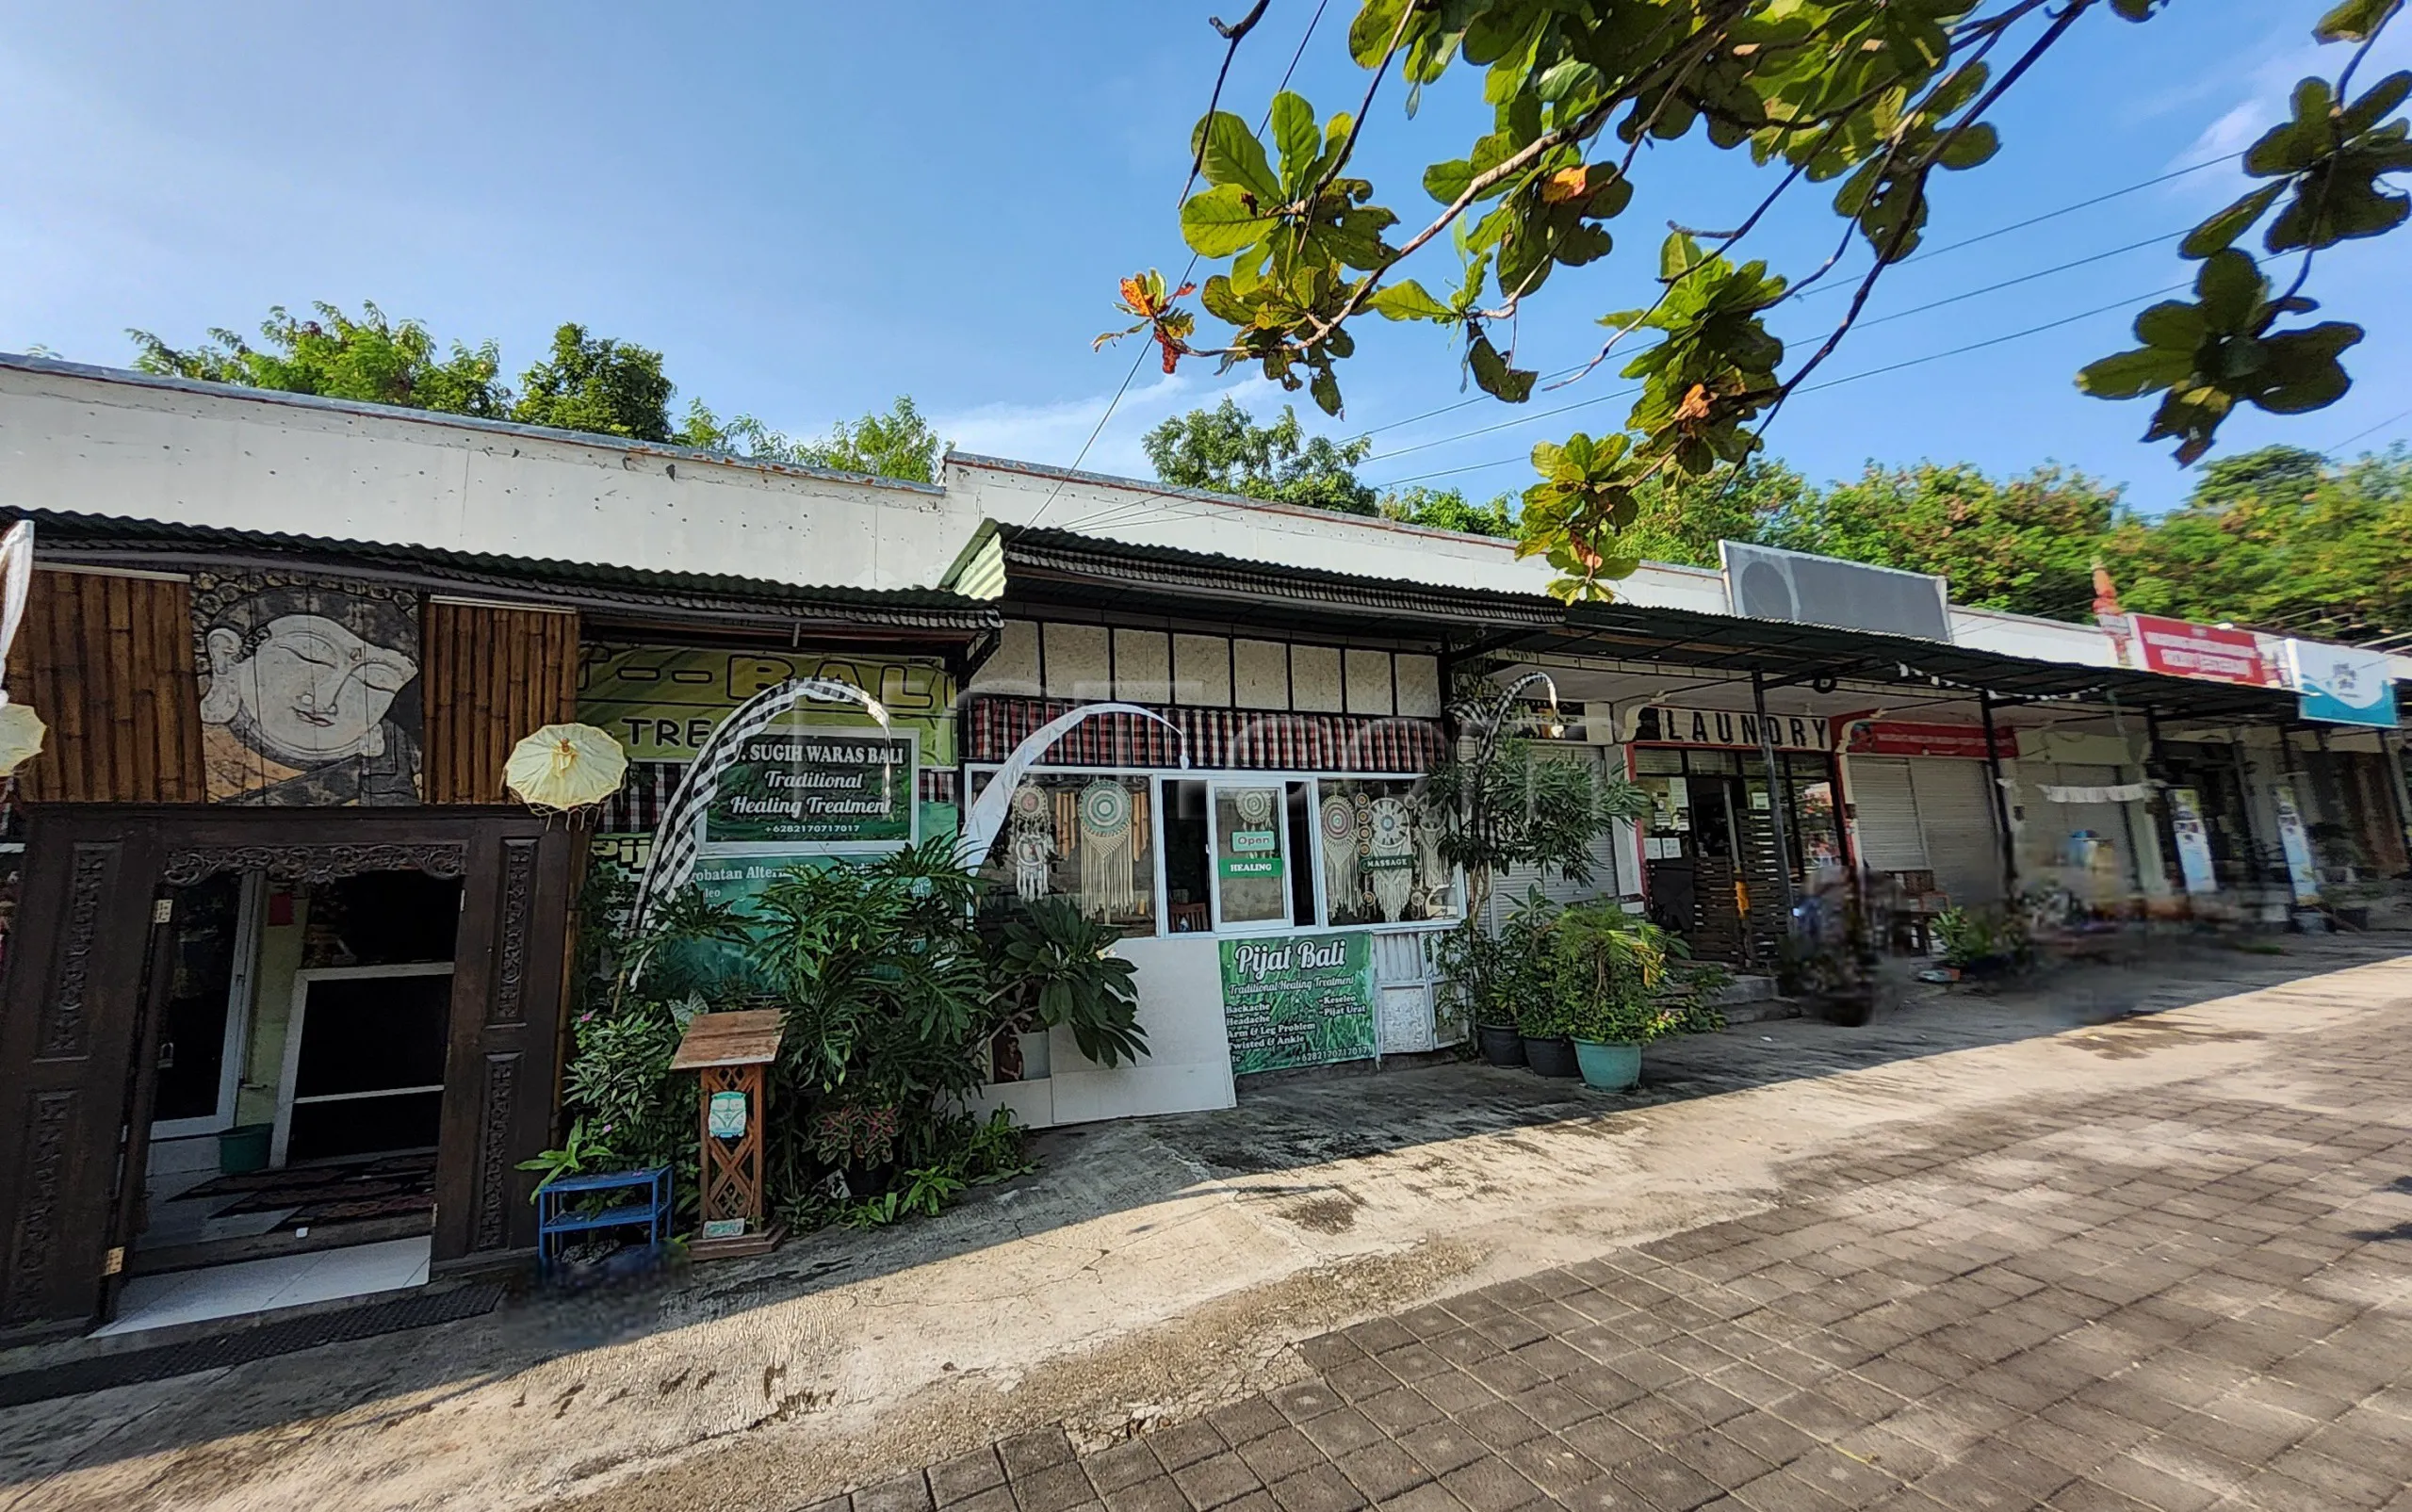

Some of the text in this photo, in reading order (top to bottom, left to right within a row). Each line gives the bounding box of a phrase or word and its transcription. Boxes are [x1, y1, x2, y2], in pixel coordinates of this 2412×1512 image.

[1666, 709, 1826, 749] LAUNDRY
[749, 743, 803, 762] SUGIH
[807, 746, 865, 764] WARAS
[867, 747, 904, 765] BALI
[764, 770, 864, 789] Traditional
[730, 795, 891, 819] Healing Treatment
[765, 824, 860, 833] +6282170717017
[1238, 836, 1269, 847] Open
[1230, 863, 1272, 872] HEALING
[1367, 858, 1408, 868] MASSAGE
[1235, 939, 1346, 980] Pijat Bali
[1229, 975, 1355, 996] Traditional Healing Treatment
[1226, 1003, 1270, 1014] Backache
[1346, 1004, 1366, 1014] Urat
[1226, 1015, 1271, 1026] Headache
[1261, 1026, 1276, 1035] Leg
[1278, 1022, 1315, 1033] Problem
[1277, 1034, 1304, 1045] Ankle
